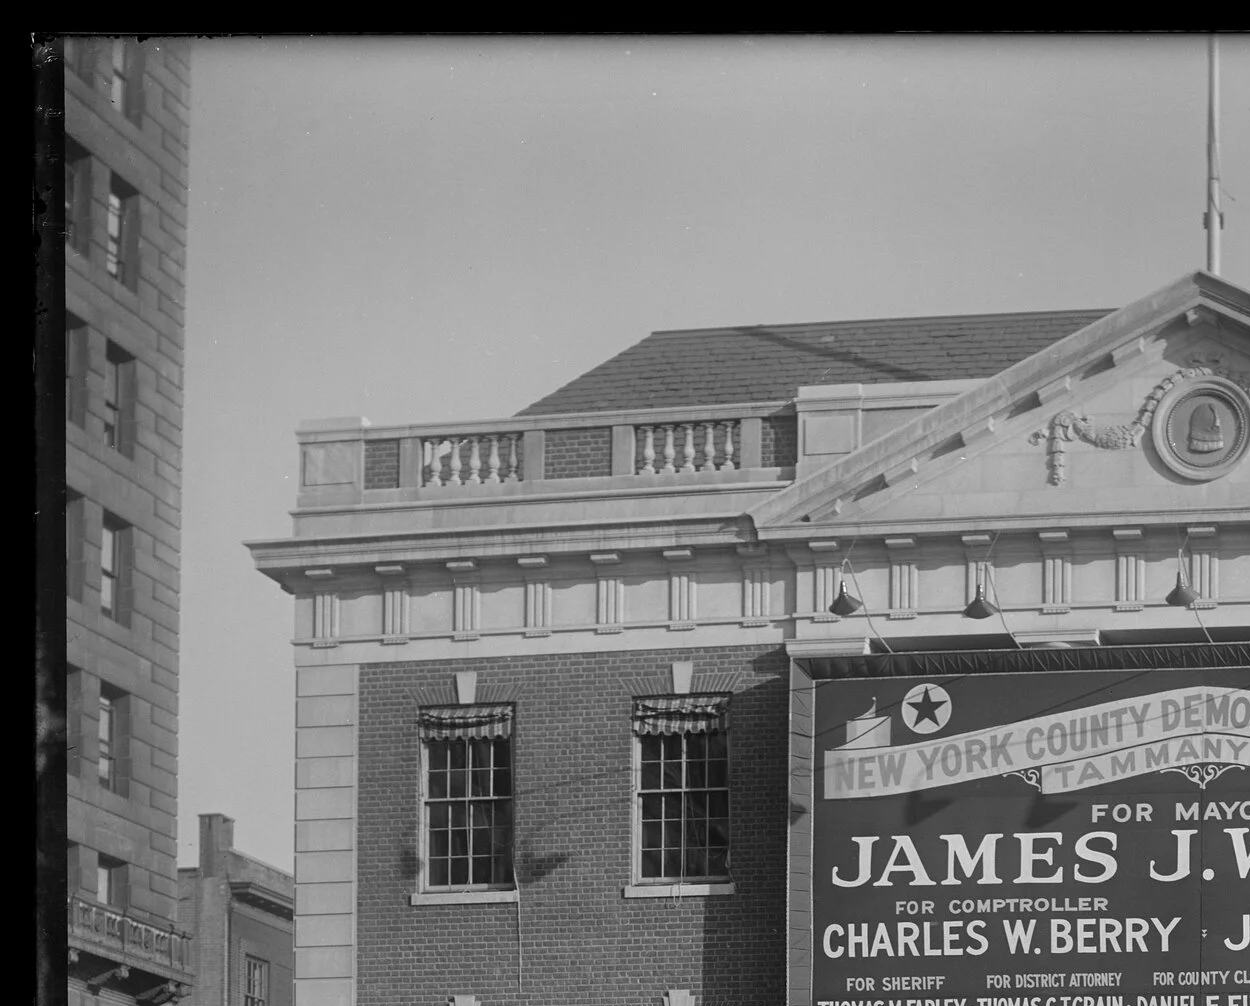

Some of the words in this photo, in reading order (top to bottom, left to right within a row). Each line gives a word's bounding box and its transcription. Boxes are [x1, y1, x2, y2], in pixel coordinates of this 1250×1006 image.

[835, 753, 906, 791] NEW
[917, 733, 1014, 780] YORK
[1025, 702, 1151, 760] COUNTY
[1055, 738, 1248, 788] TAMMANY
[1091, 803, 1153, 823] FOR
[832, 831, 1117, 887] JAMES
[895, 900, 935, 915] FOR
[948, 897, 1108, 914] COMPTROLLER
[823, 920, 989, 958] CHARLES
[846, 977, 875, 992] FOR
[882, 976, 946, 991] SHERIFF
[986, 974, 1011, 989] FOR
[1015, 973, 1066, 989] DISTRICT
[1069, 972, 1122, 987] ATTORNEY
[1153, 971, 1175, 986] FOR
[1178, 970, 1230, 986] COUNTY
